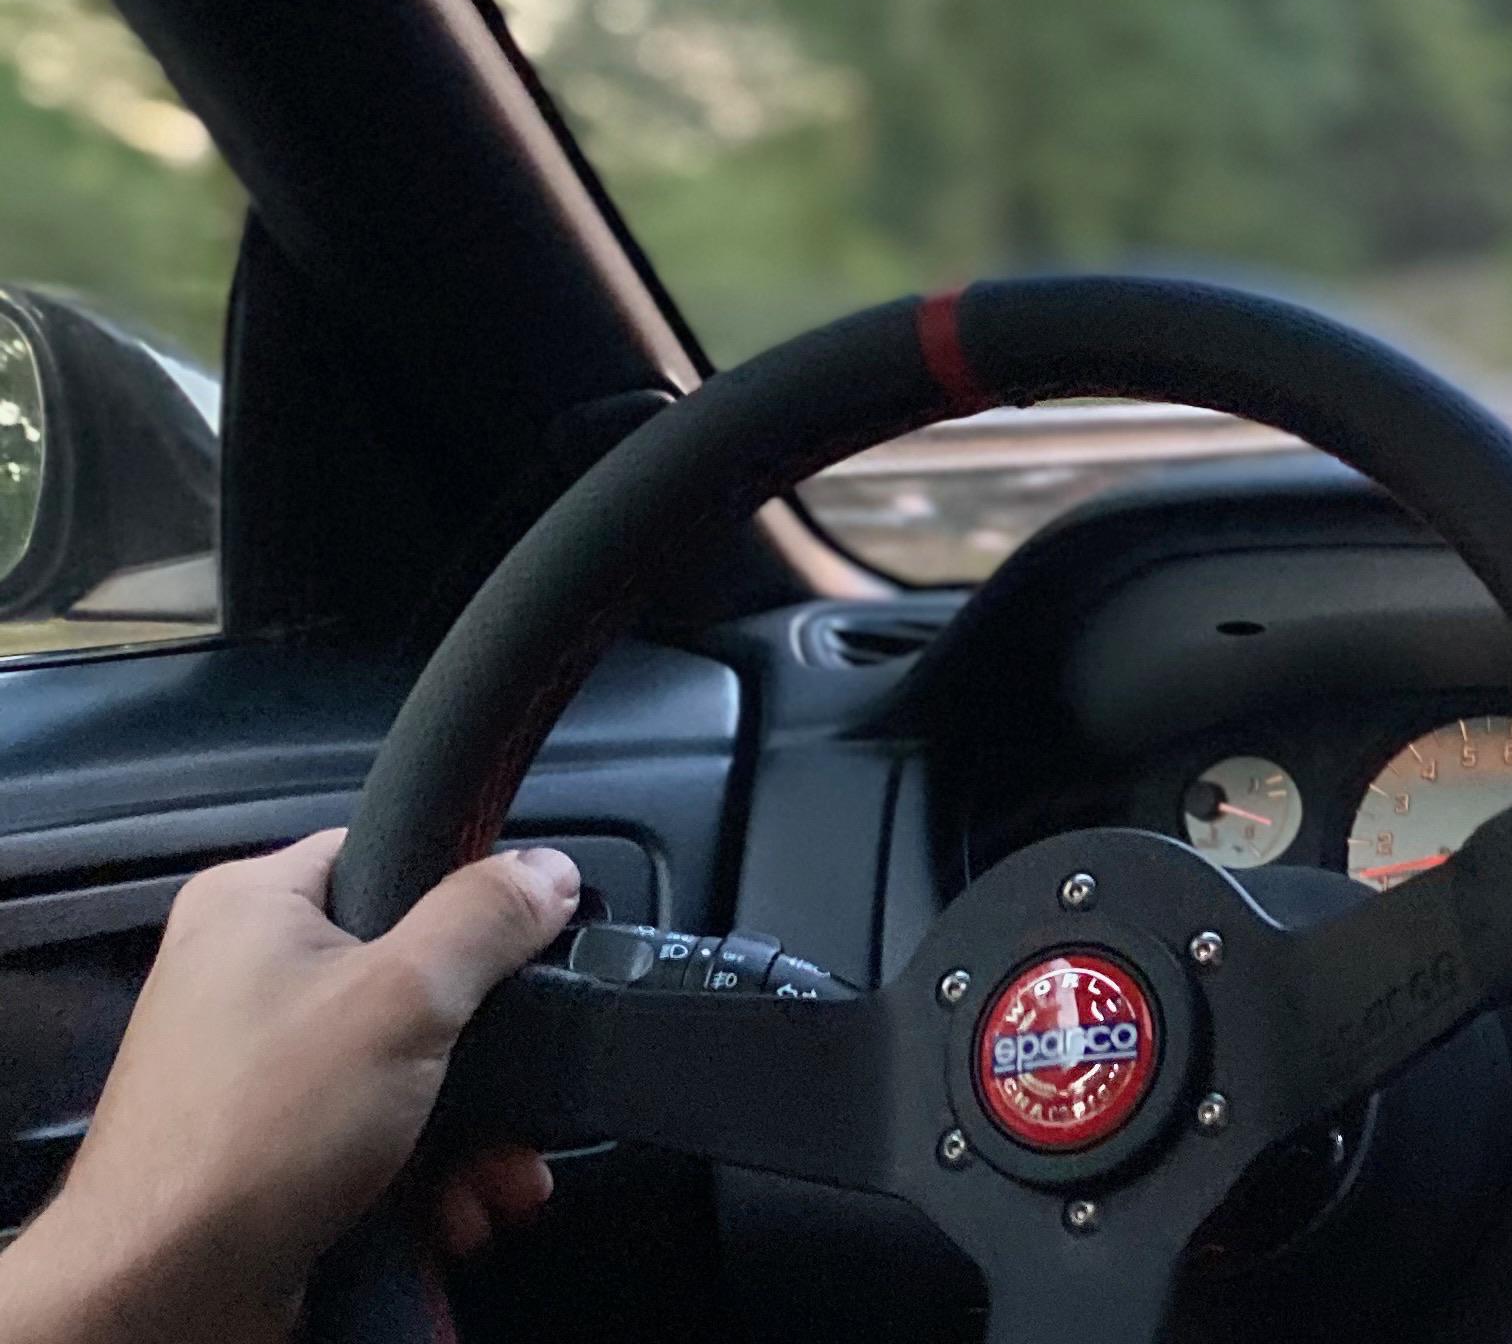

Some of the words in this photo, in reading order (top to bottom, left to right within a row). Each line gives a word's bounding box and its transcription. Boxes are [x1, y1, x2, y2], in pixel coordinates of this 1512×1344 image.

[1461, 744, 1477, 767] 5
[1421, 760, 1436, 780] 4
[1395, 793, 1409, 814] 3
[1377, 832, 1392, 855] 2
[994, 1023, 1138, 1074] sparco
